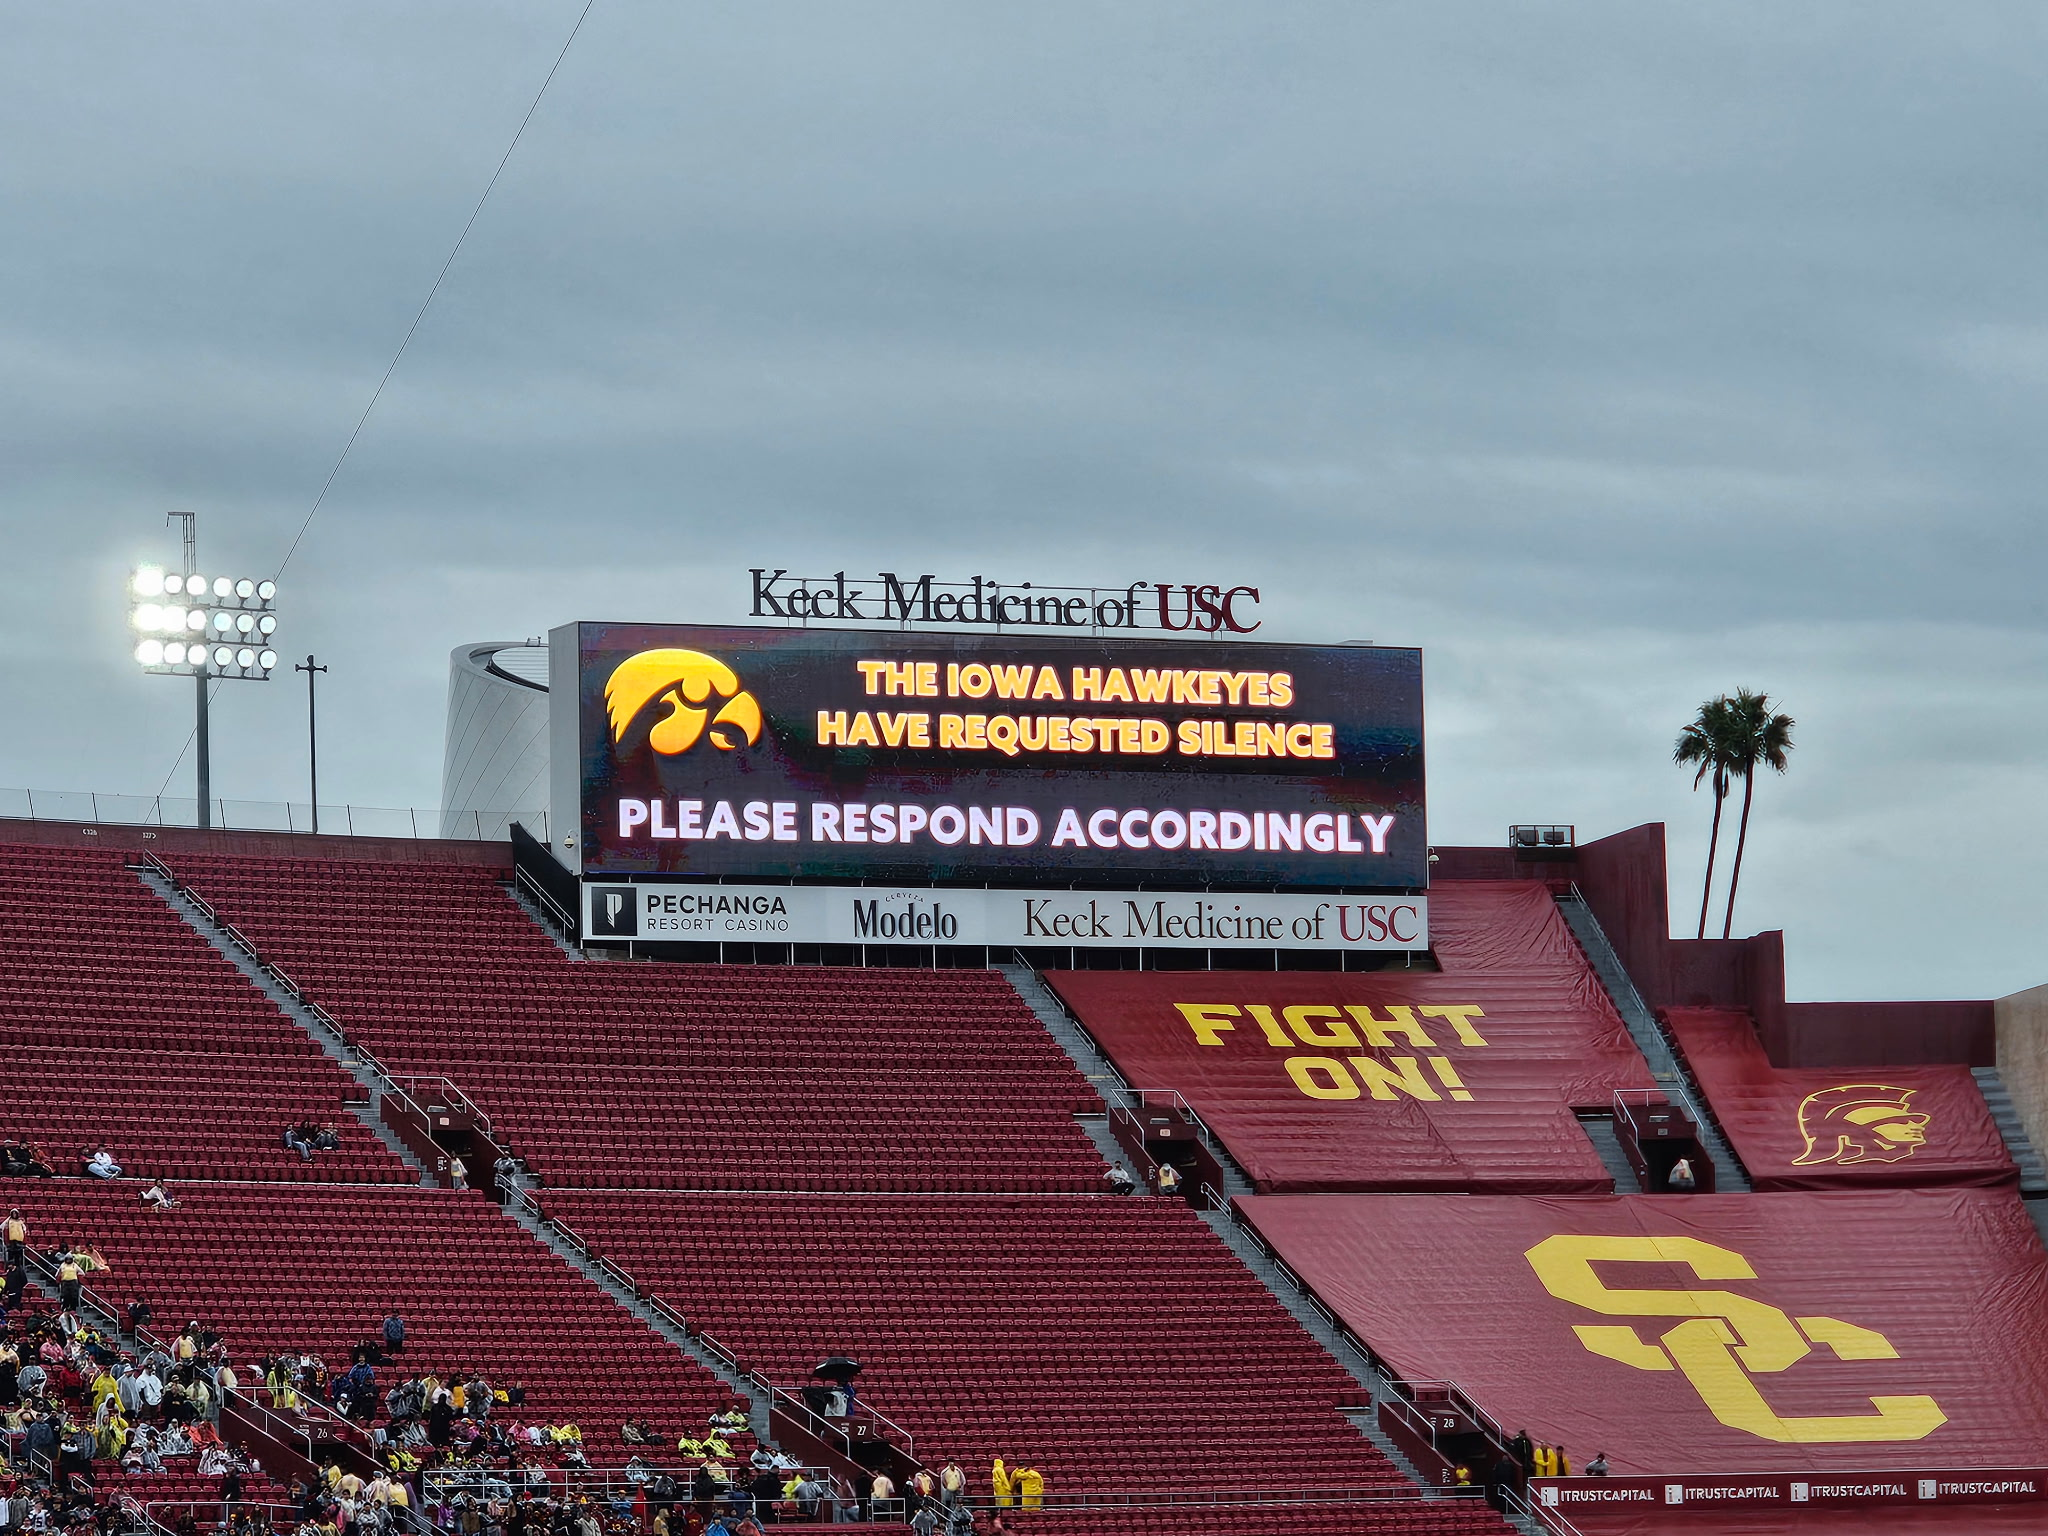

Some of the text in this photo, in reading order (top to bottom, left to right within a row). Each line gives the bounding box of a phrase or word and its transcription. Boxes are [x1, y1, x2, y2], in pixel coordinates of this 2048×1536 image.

[749, 568, 1262, 633] Keck Medicine of USC
[856, 660, 1294, 708] THE IOWA HAWKEYES
[817, 710, 1336, 759] HAVE REQUESTED SILENCE
[618, 799, 1396, 854] PLEASE RESPOND ACCORDINGLY
[647, 895, 787, 915] PECHANGA
[853, 899, 958, 940] Modelo
[647, 918, 789, 932] RESORT CASINO
[1023, 898, 1419, 943] Keck Medicine of USC
[1173, 1003, 1489, 1048] FIGHT
[1283, 1055, 1475, 1101] ON!
[1523, 1234, 1949, 1443] SC
[316, 1427, 328, 1439] 26
[857, 1425, 867, 1436] 27
[1443, 1417, 1455, 1428] 28
[1560, 1488, 1655, 1502] ITRUSTCAPITAL
[1685, 1486, 1780, 1500] ITRUSTCAPITAL
[1810, 1484, 1907, 1497] ITRUSTCAPITAL
[1939, 1481, 2036, 1495] ITRUSTCAPITAL
